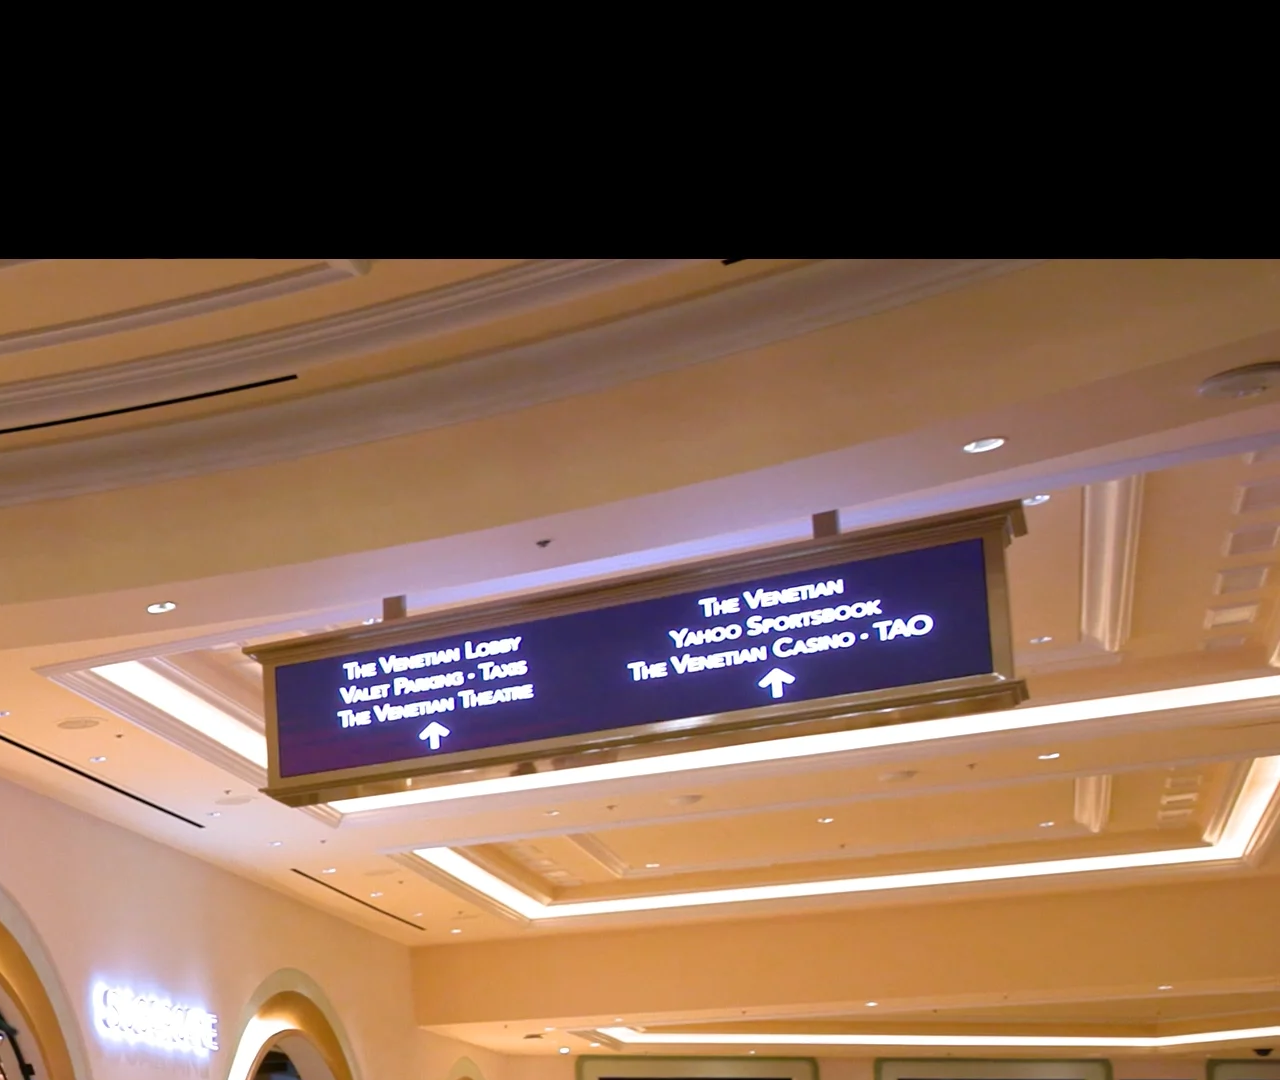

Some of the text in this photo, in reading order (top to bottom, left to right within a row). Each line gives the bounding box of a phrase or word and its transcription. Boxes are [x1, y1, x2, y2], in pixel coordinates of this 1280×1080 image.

[698, 579, 844, 617] THE VENETIAN
[669, 599, 882, 648] YAHOO SPORTSBOOK
[343, 636, 522, 680] THE VENETIAN LOBBY
[627, 614, 934, 681] THE VENETIAN CASINO TAO
[339, 660, 529, 704] VALET PARKING TAXIS
[337, 684, 535, 728] THE VENETIAN THEATRE
